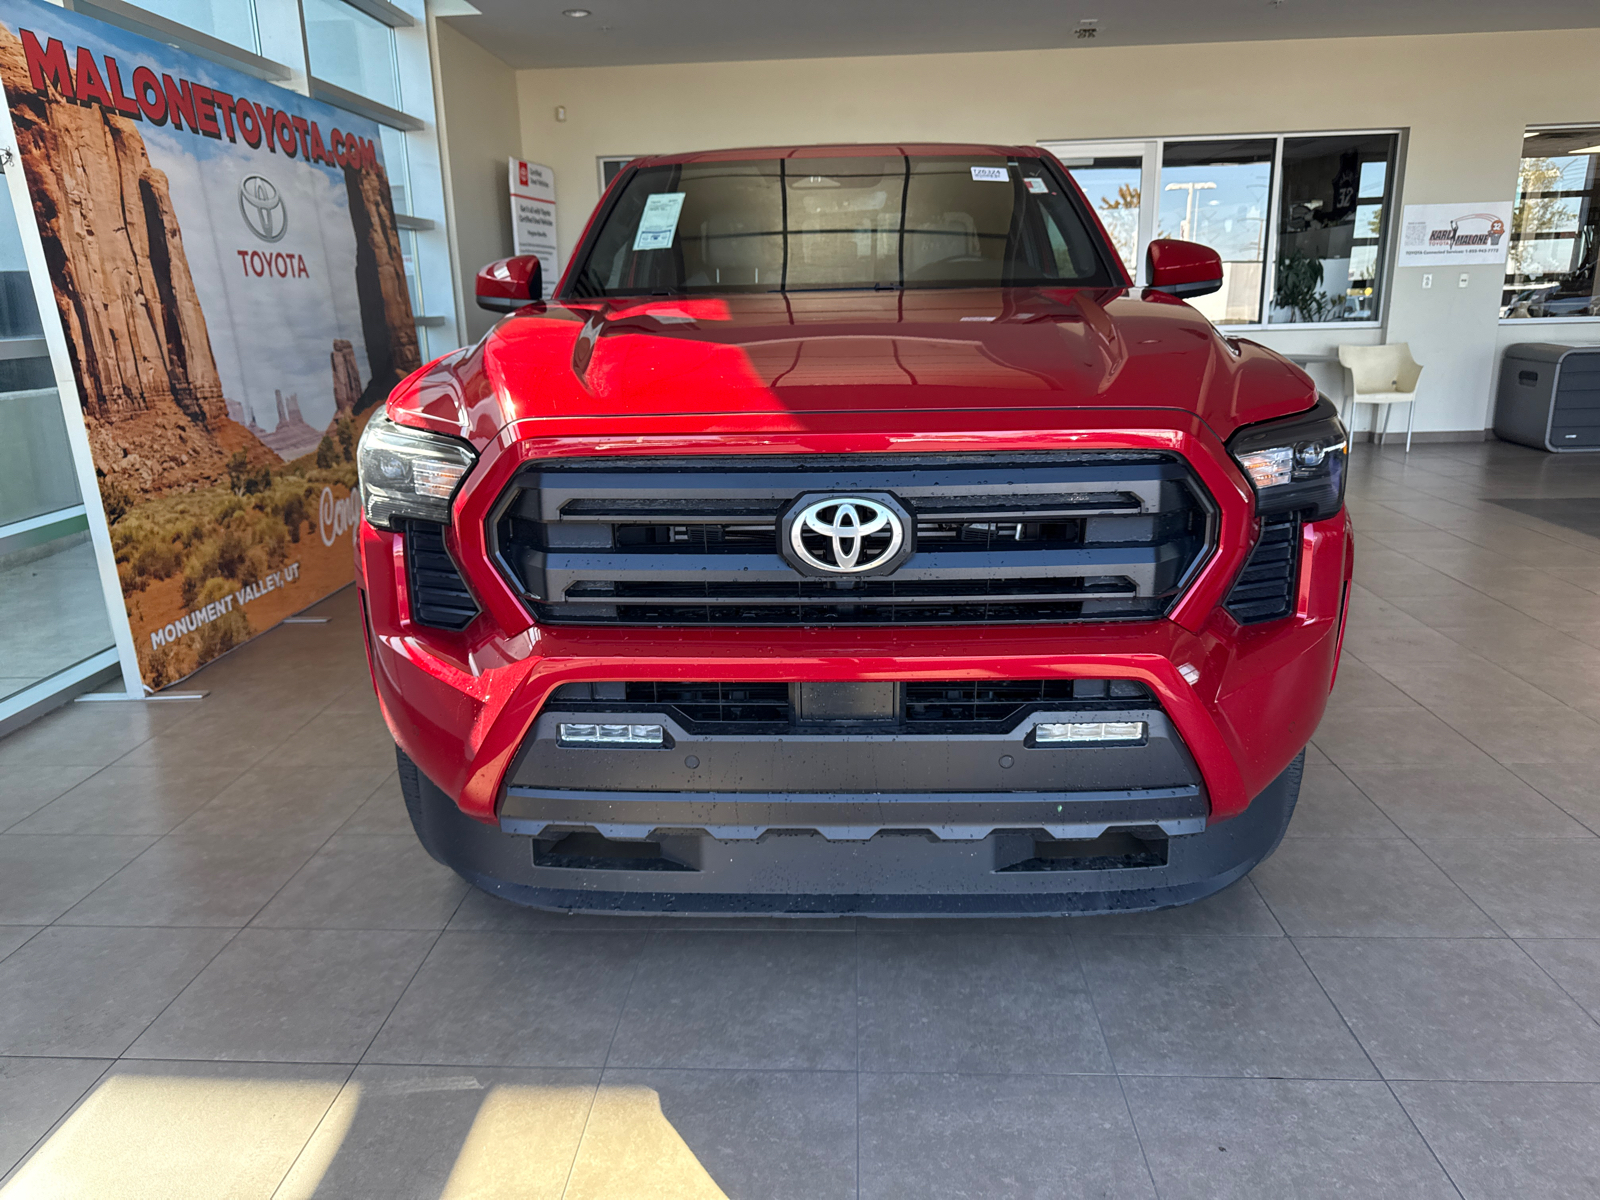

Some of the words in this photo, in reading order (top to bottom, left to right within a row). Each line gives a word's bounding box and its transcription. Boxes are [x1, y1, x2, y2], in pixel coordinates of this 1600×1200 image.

[19, 28, 381, 174] MALONETOYOTA.COM
[1336, 187, 1354, 208] 32
[1430, 230, 1453, 240] KARL
[1455, 234, 1489, 245] MALONE
[237, 250, 310, 279] TOYOTA
[150, 594, 234, 651] MONUMENT
[235, 572, 285, 606] VALLEY,
[284, 562, 300, 583] UT
